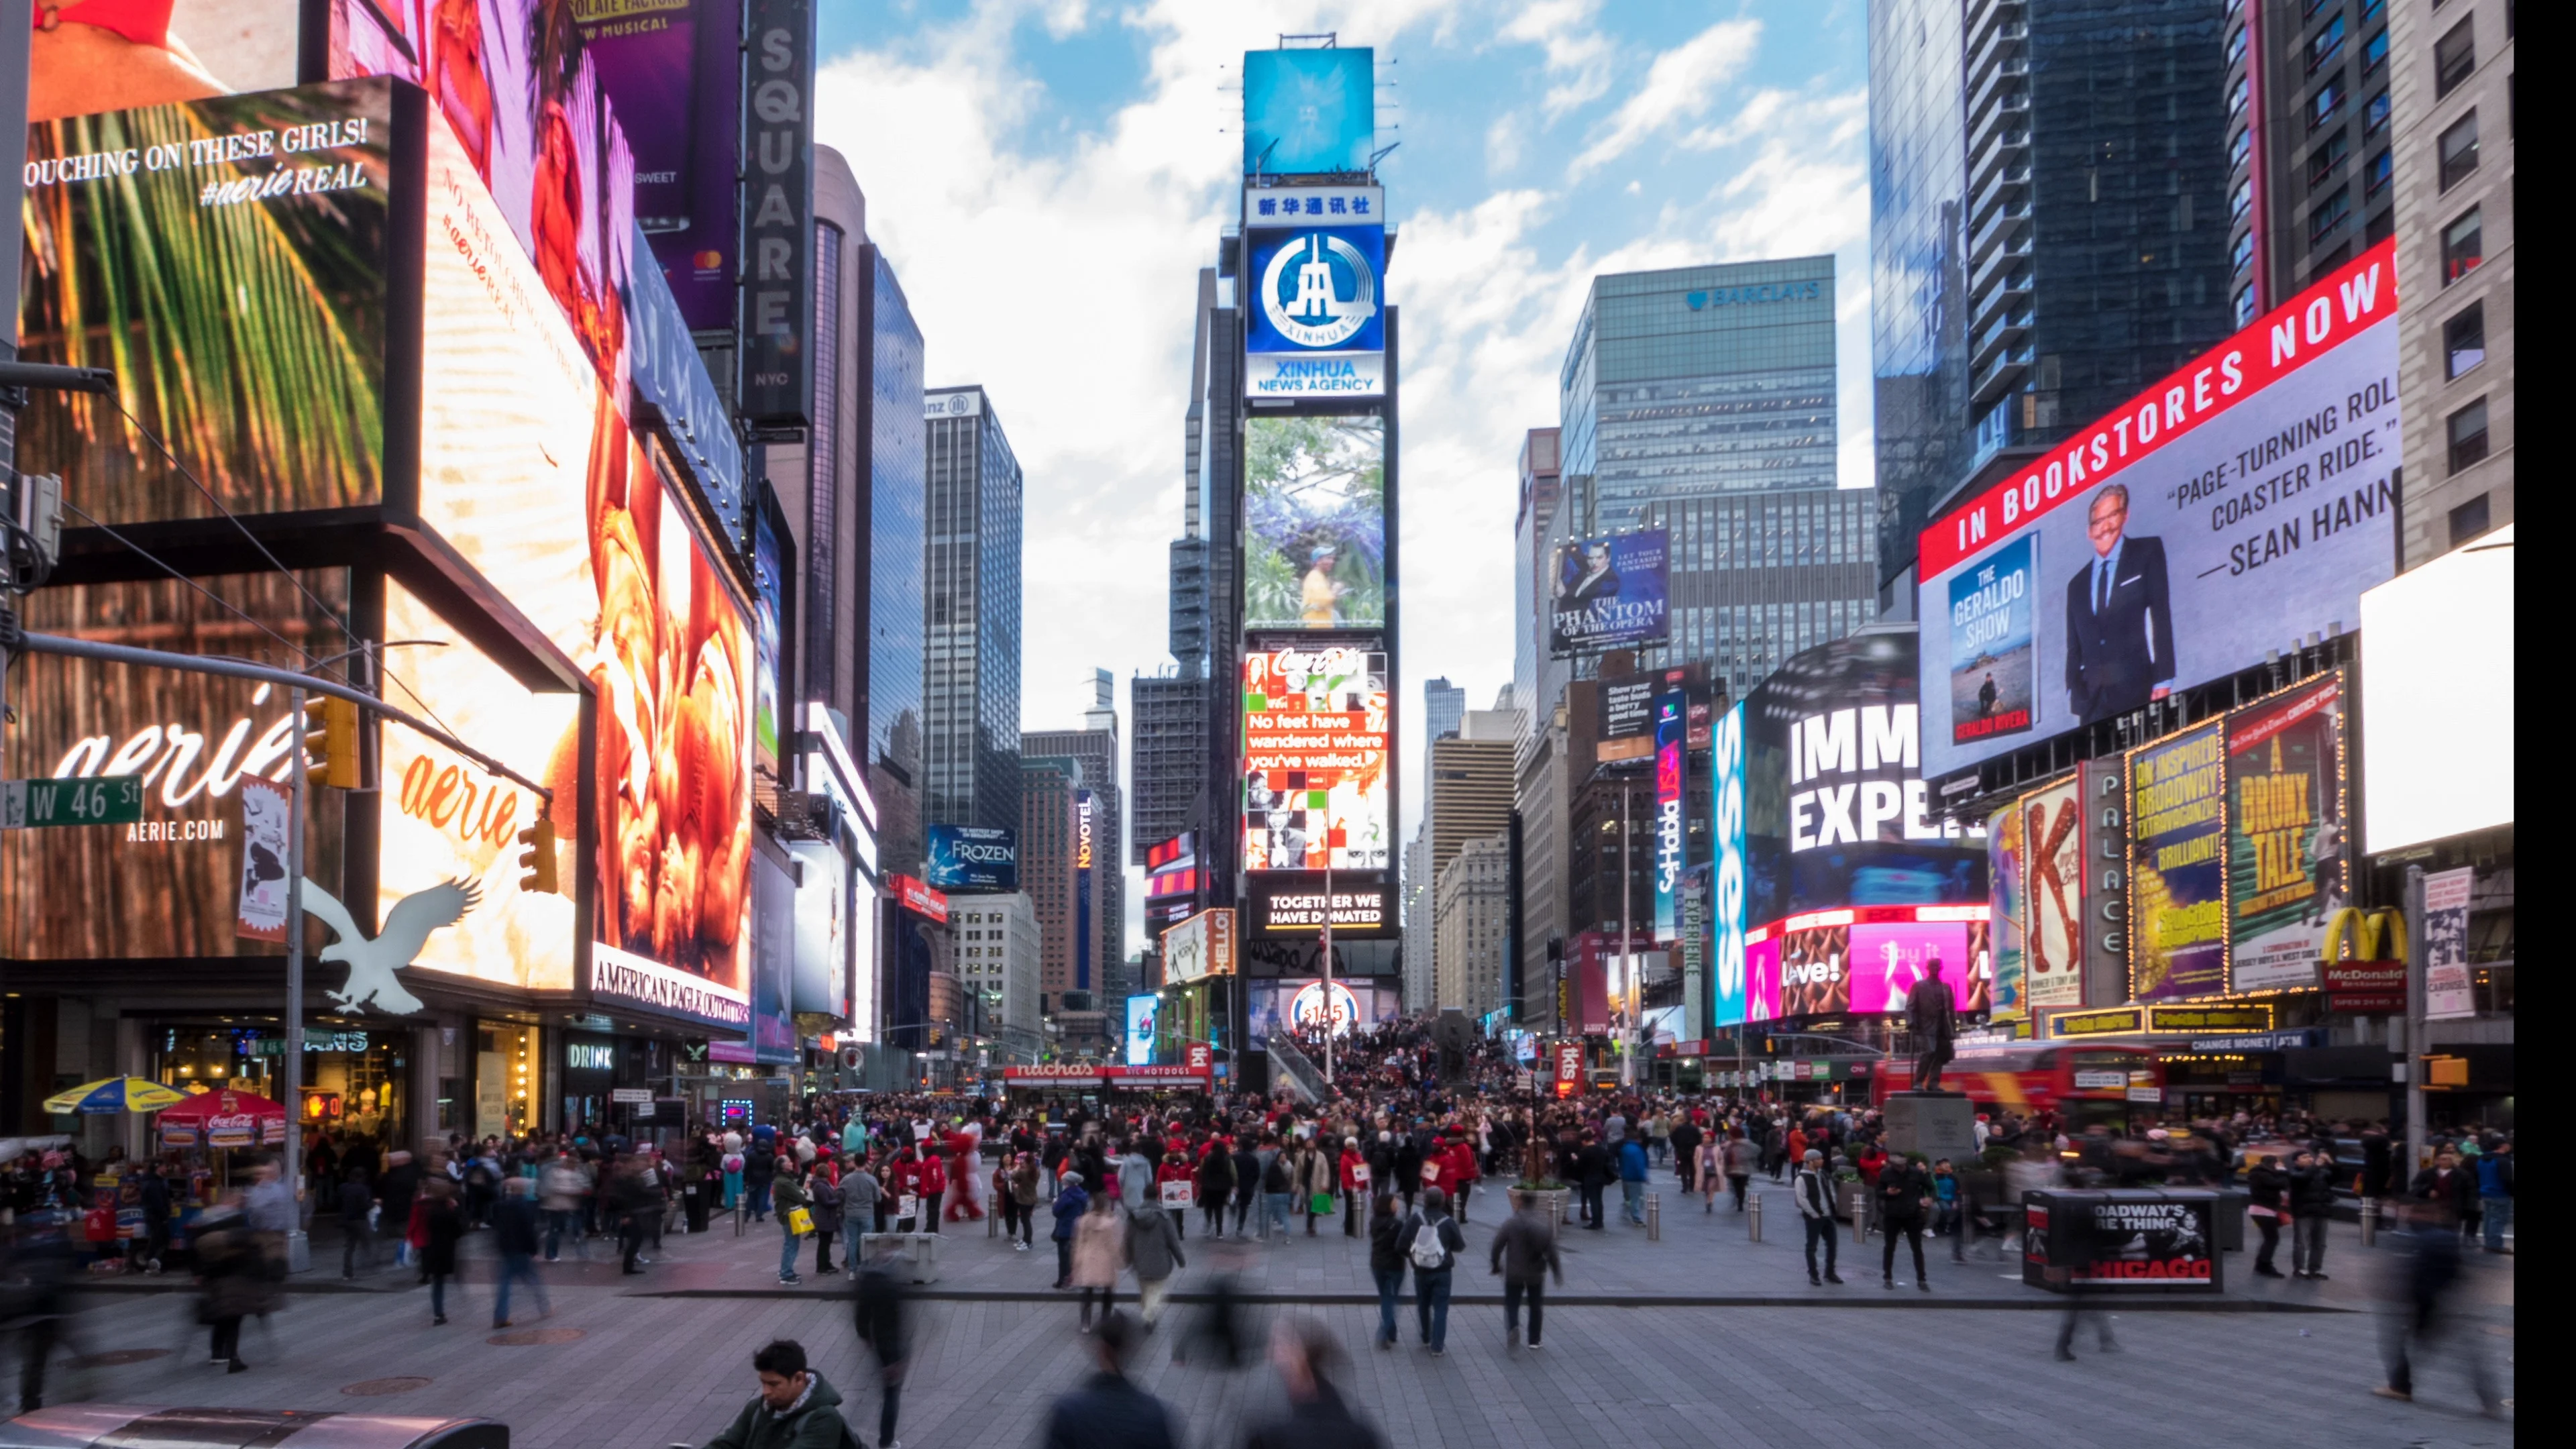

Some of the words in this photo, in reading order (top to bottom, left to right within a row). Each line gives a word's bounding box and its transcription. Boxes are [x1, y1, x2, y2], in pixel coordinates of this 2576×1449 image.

[602, 17, 668, 38] MUSICAL
[146, 144, 184, 173] ON
[189, 130, 274, 166] THESE
[282, 118, 368, 154] GIRLS!
[635, 172, 677, 184] SWEET
[754, 28, 801, 335] SQUARE
[1258, 197, 1371, 215] 新华通讯社
[1713, 282, 1821, 307] BARCLAYS
[1285, 323, 1351, 345] XINHUA
[755, 373, 788, 386] NYC
[1276, 360, 1356, 379] XINHUA
[1258, 379, 1304, 392] NEWS
[1307, 378, 1375, 391] AGENCY
[2348, 370, 2401, 423] ROL
[1958, 506, 1986, 551] IN
[2002, 351, 2244, 524] BOOKSTORES
[2212, 463, 2310, 531] COASTER
[1978, 566, 1996, 588] THE
[1592, 596, 1620, 608] THE
[1954, 568, 2025, 627] GERALDO
[1553, 599, 1664, 629] PHANTOM
[1562, 626, 1579, 637] OF
[1583, 622, 1609, 634] THE
[1610, 616, 1654, 630] OPERA
[1966, 607, 2010, 650] SHOW
[1609, 685, 1630, 696] Show
[1632, 682, 1652, 692] your
[1250, 715, 1273, 729] No
[1277, 714, 1308, 729] feet
[1312, 714, 1350, 729] have
[1629, 709, 1649, 718] time
[1995, 708, 2029, 732] RIVERA
[54, 683, 313, 807] aerie
[1250, 734, 1329, 749] wandered
[1333, 734, 1383, 748] where
[2136, 759, 2154, 789] AN
[2156, 733, 2218, 782] INSPIRED
[33, 789, 56, 820] W
[70, 787, 107, 818] 46
[120, 782, 140, 804] St
[401, 754, 517, 849] aerie
[2136, 762, 2218, 819] BROADWAY
[2239, 772, 2311, 837] BRONX
[127, 819, 223, 843] AERIE.COM
[1077, 796, 1091, 869] NOVOTEL
[952, 840, 1014, 863] FROZEN
[2251, 826, 2306, 893] TALE
[2102, 775, 2122, 953] PALACE
[1356, 895, 1381, 907] WE
[1271, 911, 1308, 924] HAVE
[1215, 912, 1230, 971] HELLO!
[1685, 898, 1701, 976] EXPERIENCE
[596, 959, 668, 1006] AMERICAN
[671, 987, 702, 1016] EAGLE
[2192, 1038, 2231, 1051] CHANGE
[2234, 1037, 2271, 1049] MONEY
[2277, 1034, 2302, 1048] ATM
[570, 1043, 612, 1070] DRINK
[1562, 1047, 1580, 1080] tkts
[1144, 1067, 1189, 1075] HOTDOGS
[2121, 1218, 2178, 1230] THING
[2071, 1258, 2212, 1279] HICAGO
